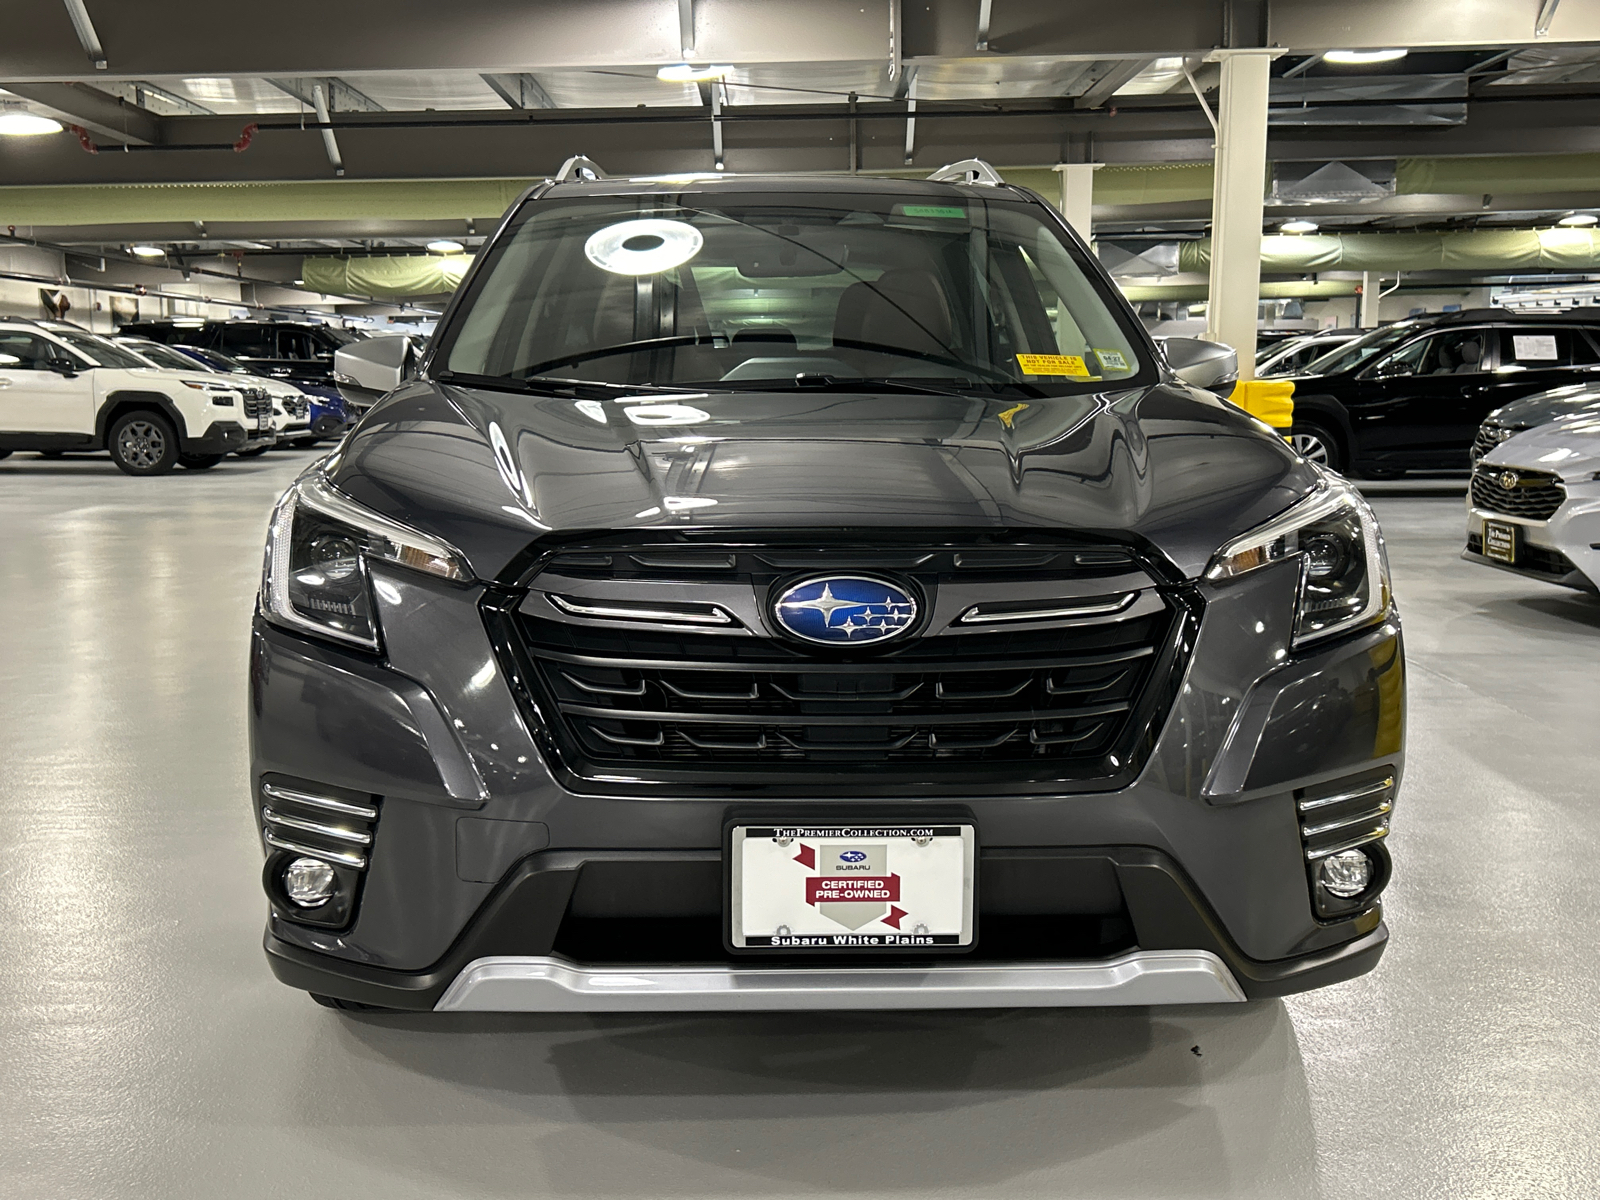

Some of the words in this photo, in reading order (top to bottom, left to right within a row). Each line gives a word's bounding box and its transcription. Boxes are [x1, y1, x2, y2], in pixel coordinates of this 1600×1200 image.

[821, 880, 885, 889] CERTIFIED
[815, 890, 891, 899] PRE-OWNED
[771, 935, 828, 946] Subaru
[833, 935, 880, 946] White
[885, 935, 934, 945] Plains
